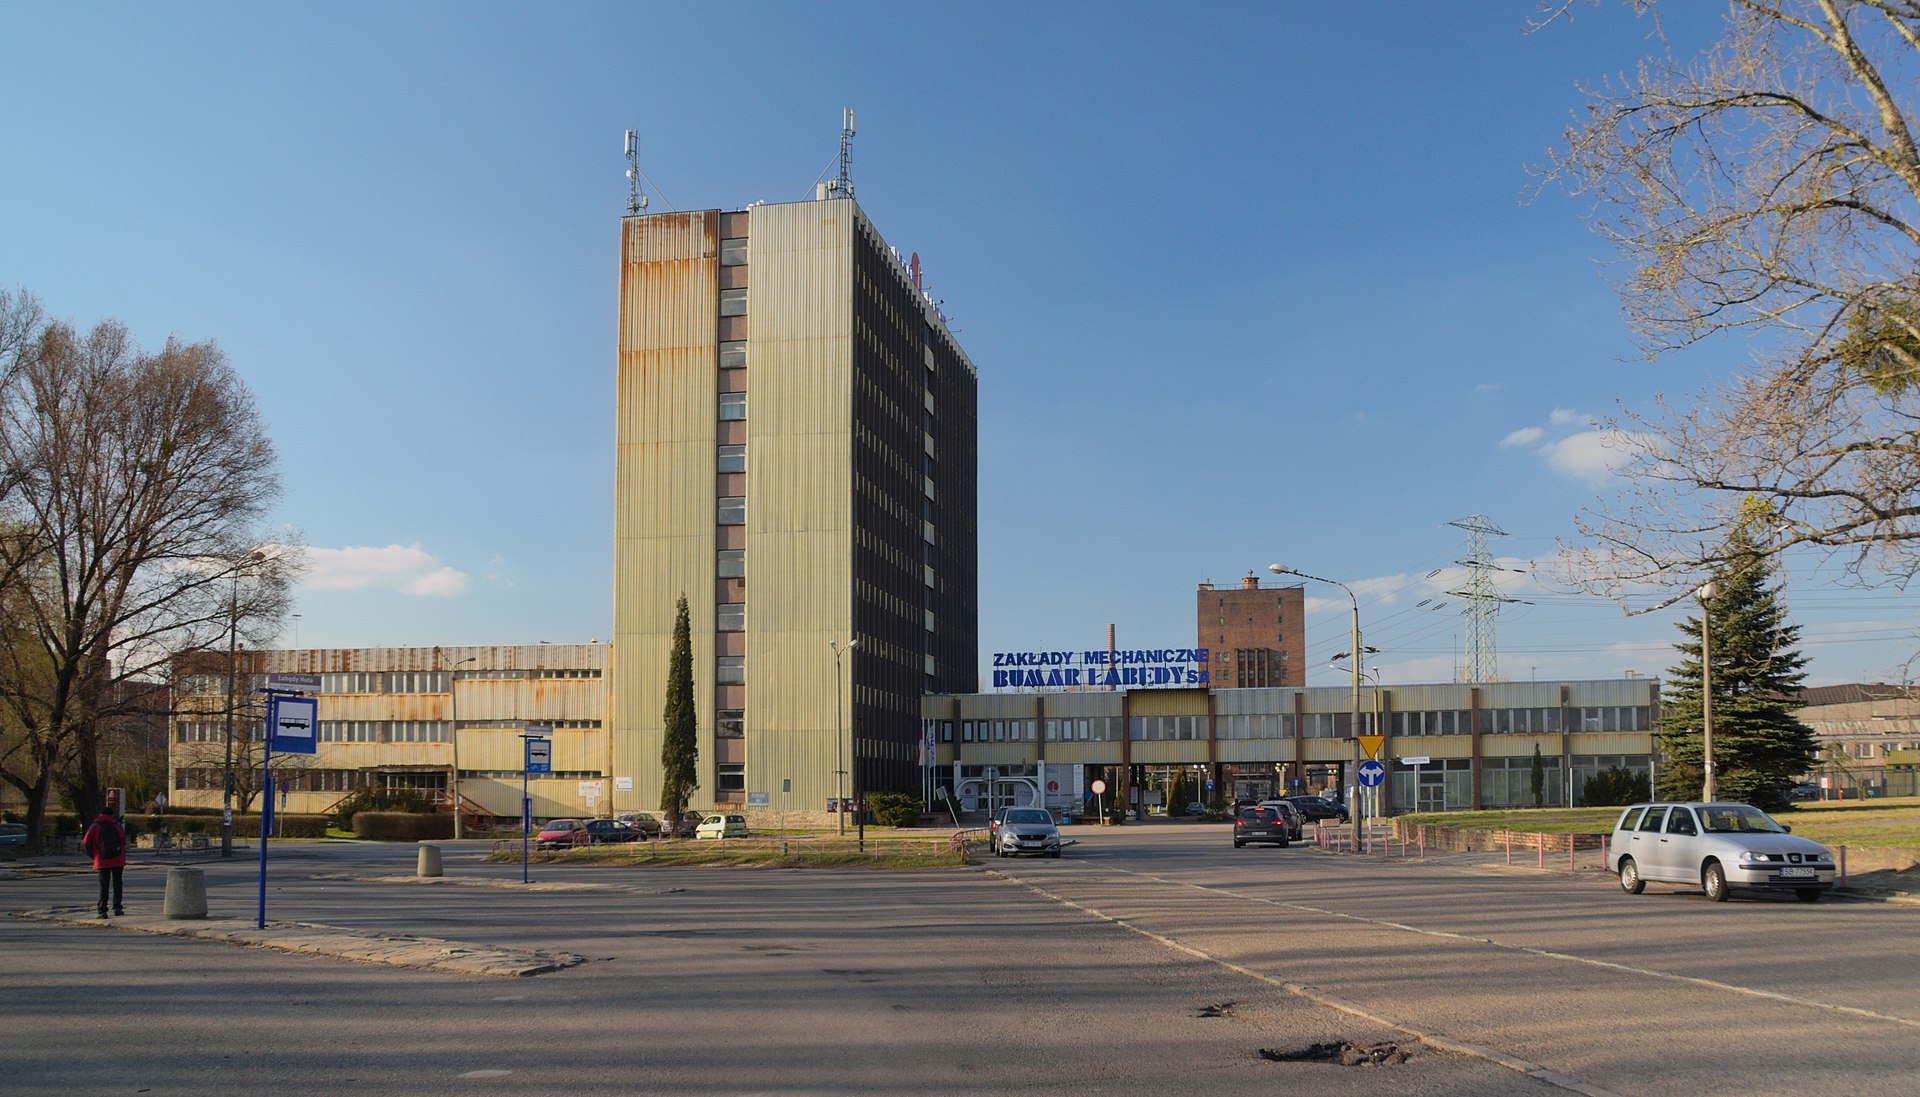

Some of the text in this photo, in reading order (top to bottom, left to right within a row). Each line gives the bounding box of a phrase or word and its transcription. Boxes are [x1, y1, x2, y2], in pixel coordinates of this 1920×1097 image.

[993, 648, 1209, 667] ZAKŁADY MECHANICZNE
[993, 666, 1210, 688] BUMAR ŁABĘDY SA
